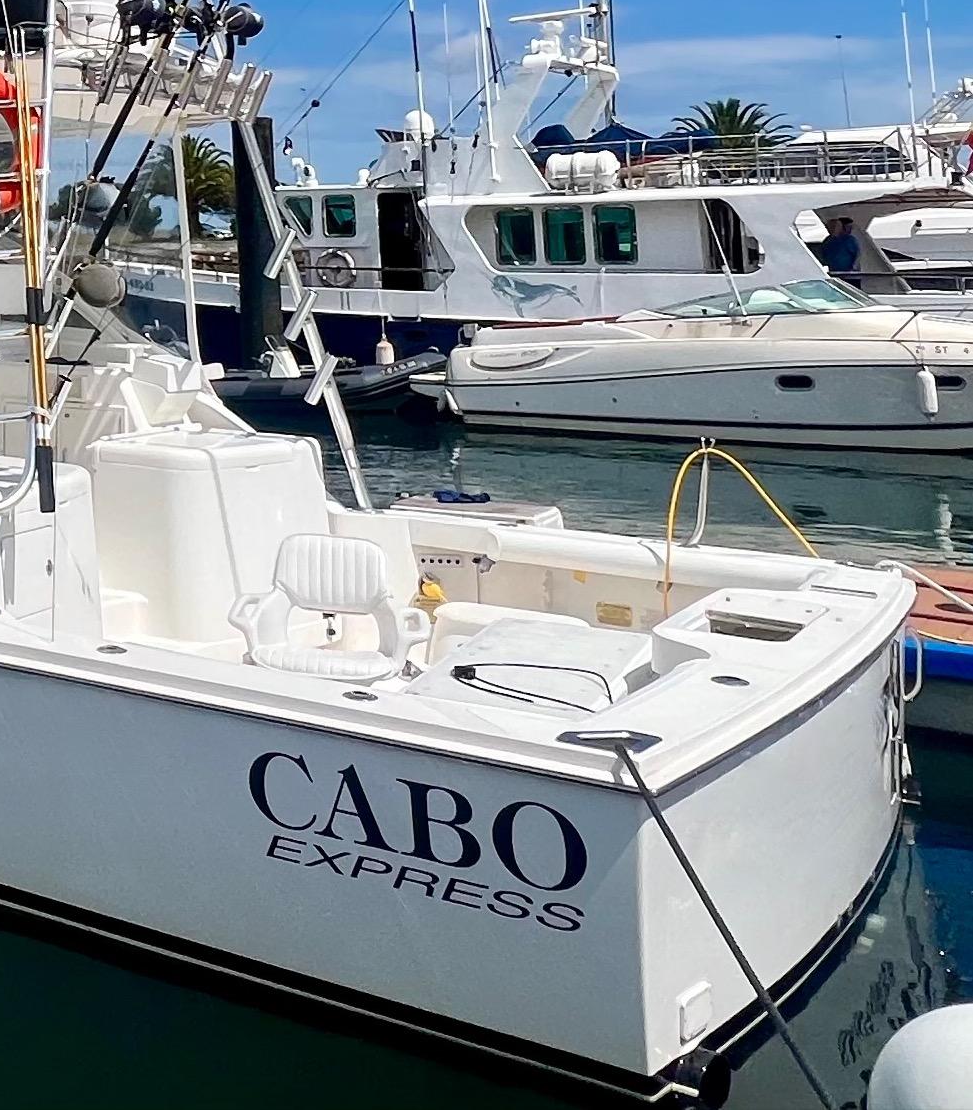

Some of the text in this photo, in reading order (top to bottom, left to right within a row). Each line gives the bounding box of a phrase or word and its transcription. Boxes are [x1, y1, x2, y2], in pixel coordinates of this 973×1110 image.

[934, 345, 948, 354] ST
[249, 751, 588, 892] CABO
[266, 835, 585, 932] EXPRESS
